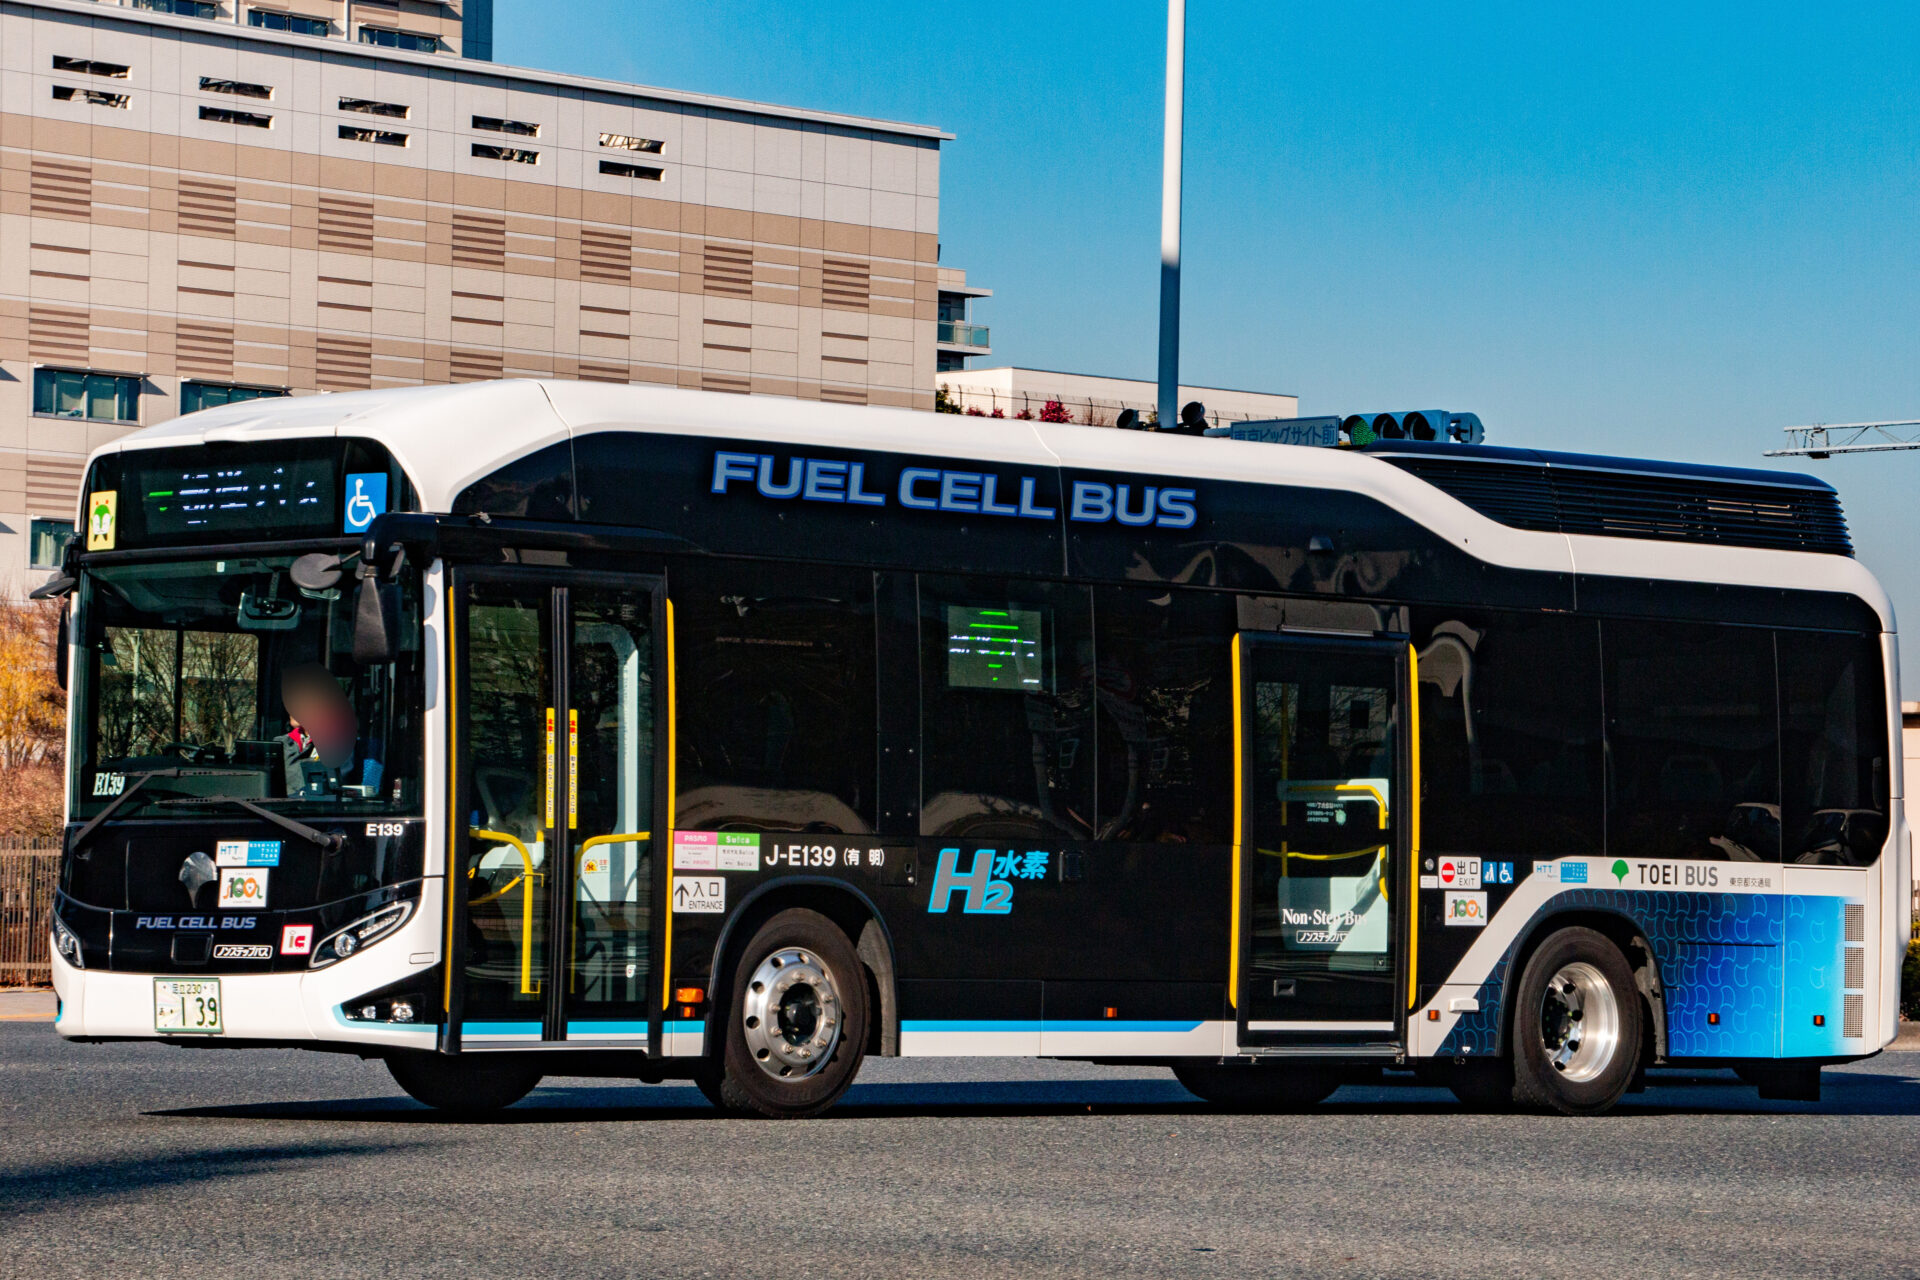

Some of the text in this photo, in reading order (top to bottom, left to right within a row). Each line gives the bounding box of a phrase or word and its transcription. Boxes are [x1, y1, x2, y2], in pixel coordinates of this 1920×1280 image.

[711, 450, 1198, 529] FUEL CELL BUS
[92, 772, 126, 796] E139
[365, 823, 404, 837] E139
[726, 835, 751, 844] Suica
[220, 845, 239, 855] HTT
[765, 844, 836, 867] J-E139
[993, 850, 1049, 880] 水素
[1457, 860, 1478, 875] 出口
[1536, 864, 1553, 873] HTT
[1637, 863, 1719, 886] TOEI BUS
[1458, 877, 1476, 887] EXIT
[693, 882, 720, 897] 入口
[688, 900, 723, 910] ENTRANCE
[136, 917, 257, 929] FUEL CELL BUS
